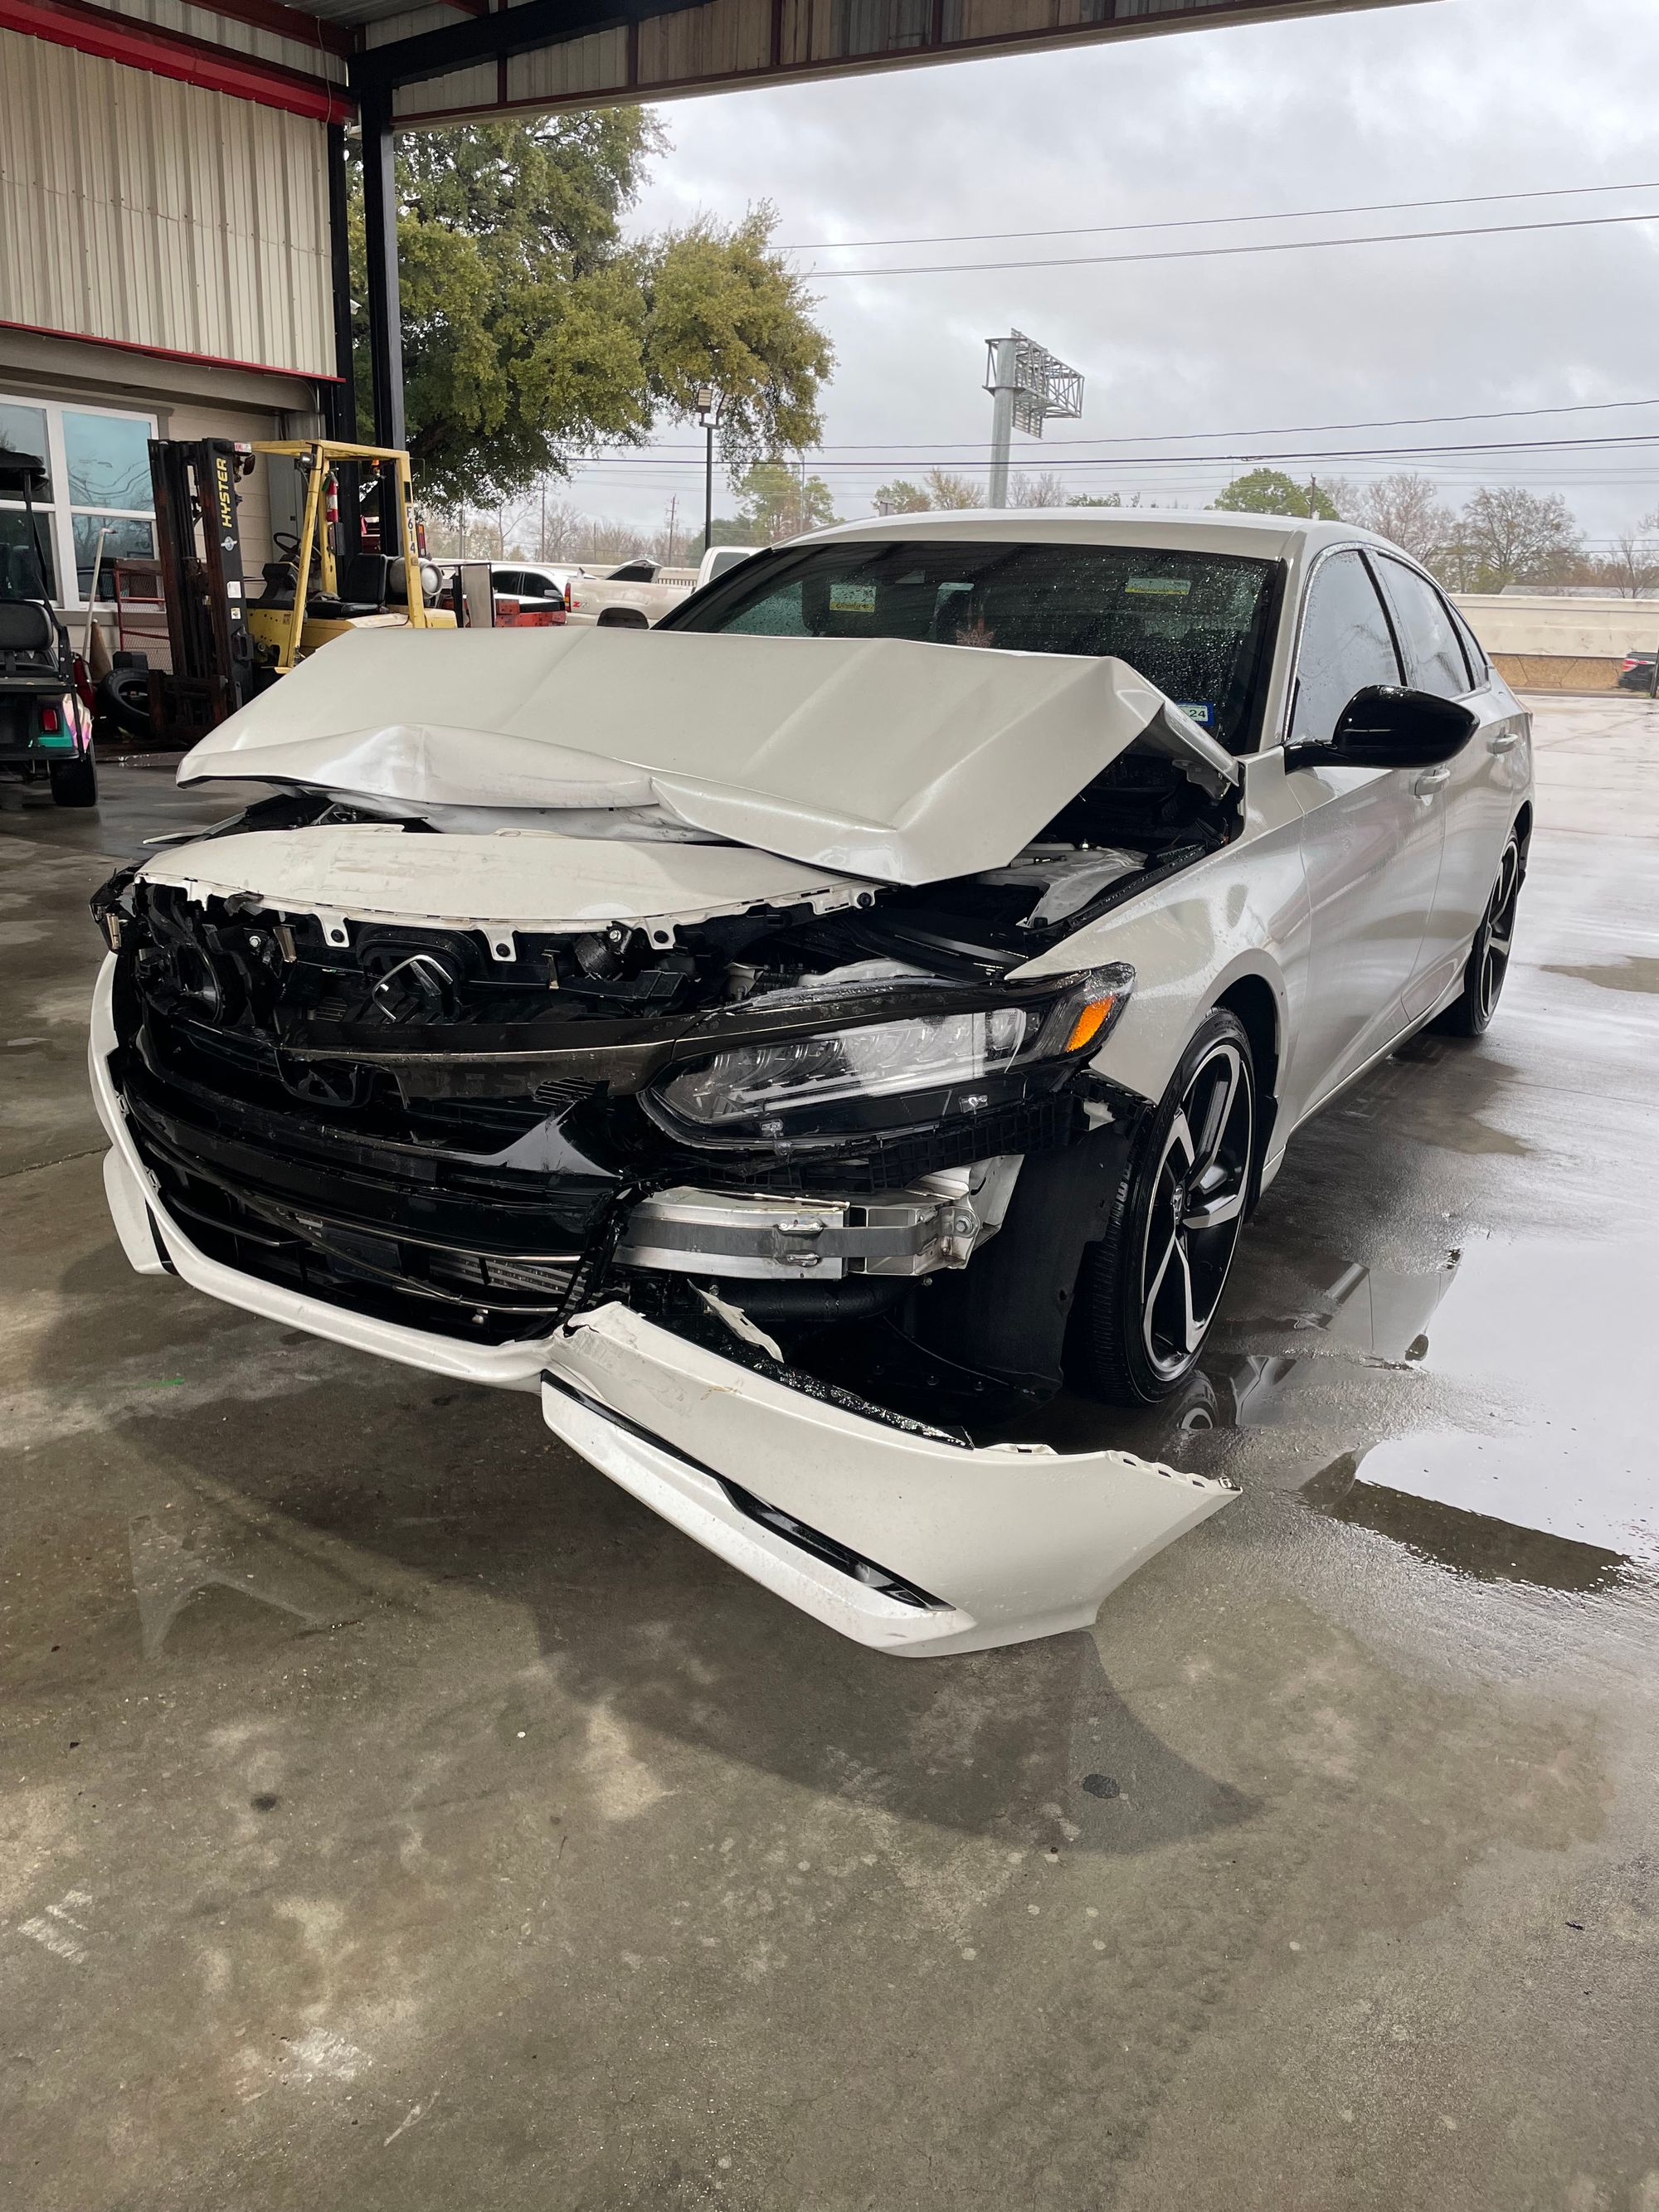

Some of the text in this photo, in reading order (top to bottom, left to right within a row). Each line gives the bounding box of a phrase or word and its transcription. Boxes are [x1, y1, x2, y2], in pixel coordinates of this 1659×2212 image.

[216, 457, 232, 527] HYSTER
[406, 507, 416, 553] F614
[1189, 709, 1206, 718] 24
